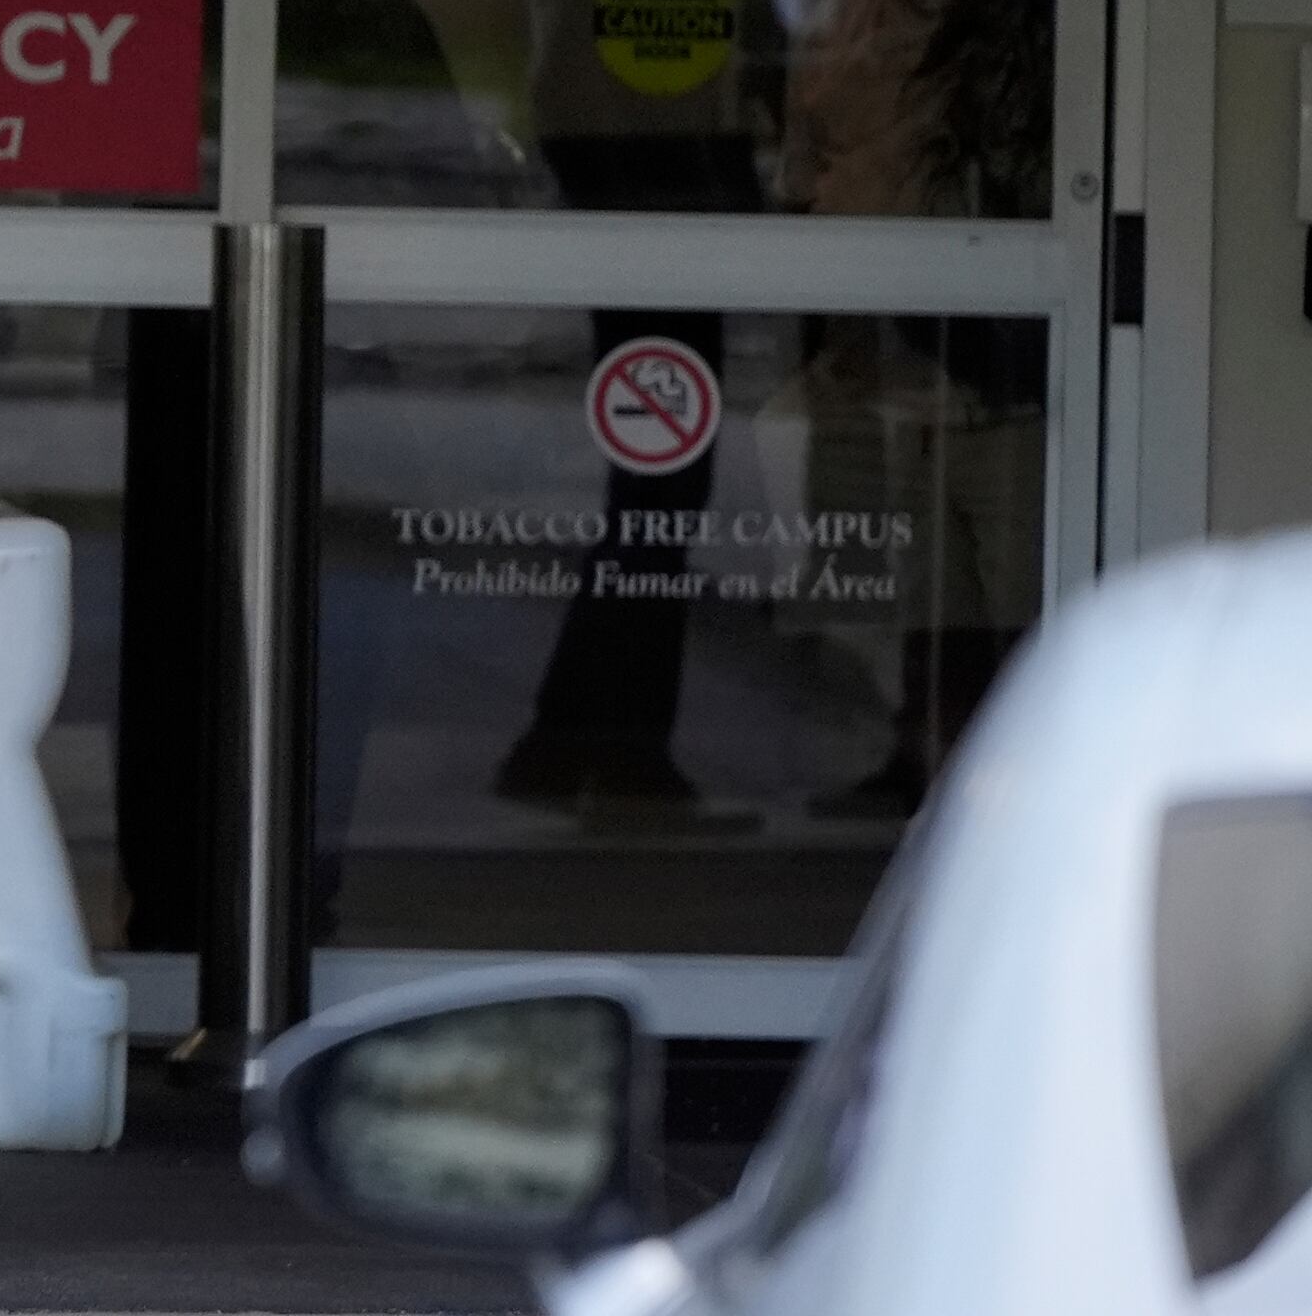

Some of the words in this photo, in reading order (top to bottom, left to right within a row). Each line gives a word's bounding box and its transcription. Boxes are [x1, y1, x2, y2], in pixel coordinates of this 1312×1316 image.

[604, 8, 724, 37] CAUTION
[391, 507, 609, 546] TOBACCO
[619, 510, 722, 546] FREE
[731, 511, 915, 548] CAMPUS
[592, 561, 705, 600] Fumar
[718, 573, 760, 601] en
[769, 568, 802, 601] el
